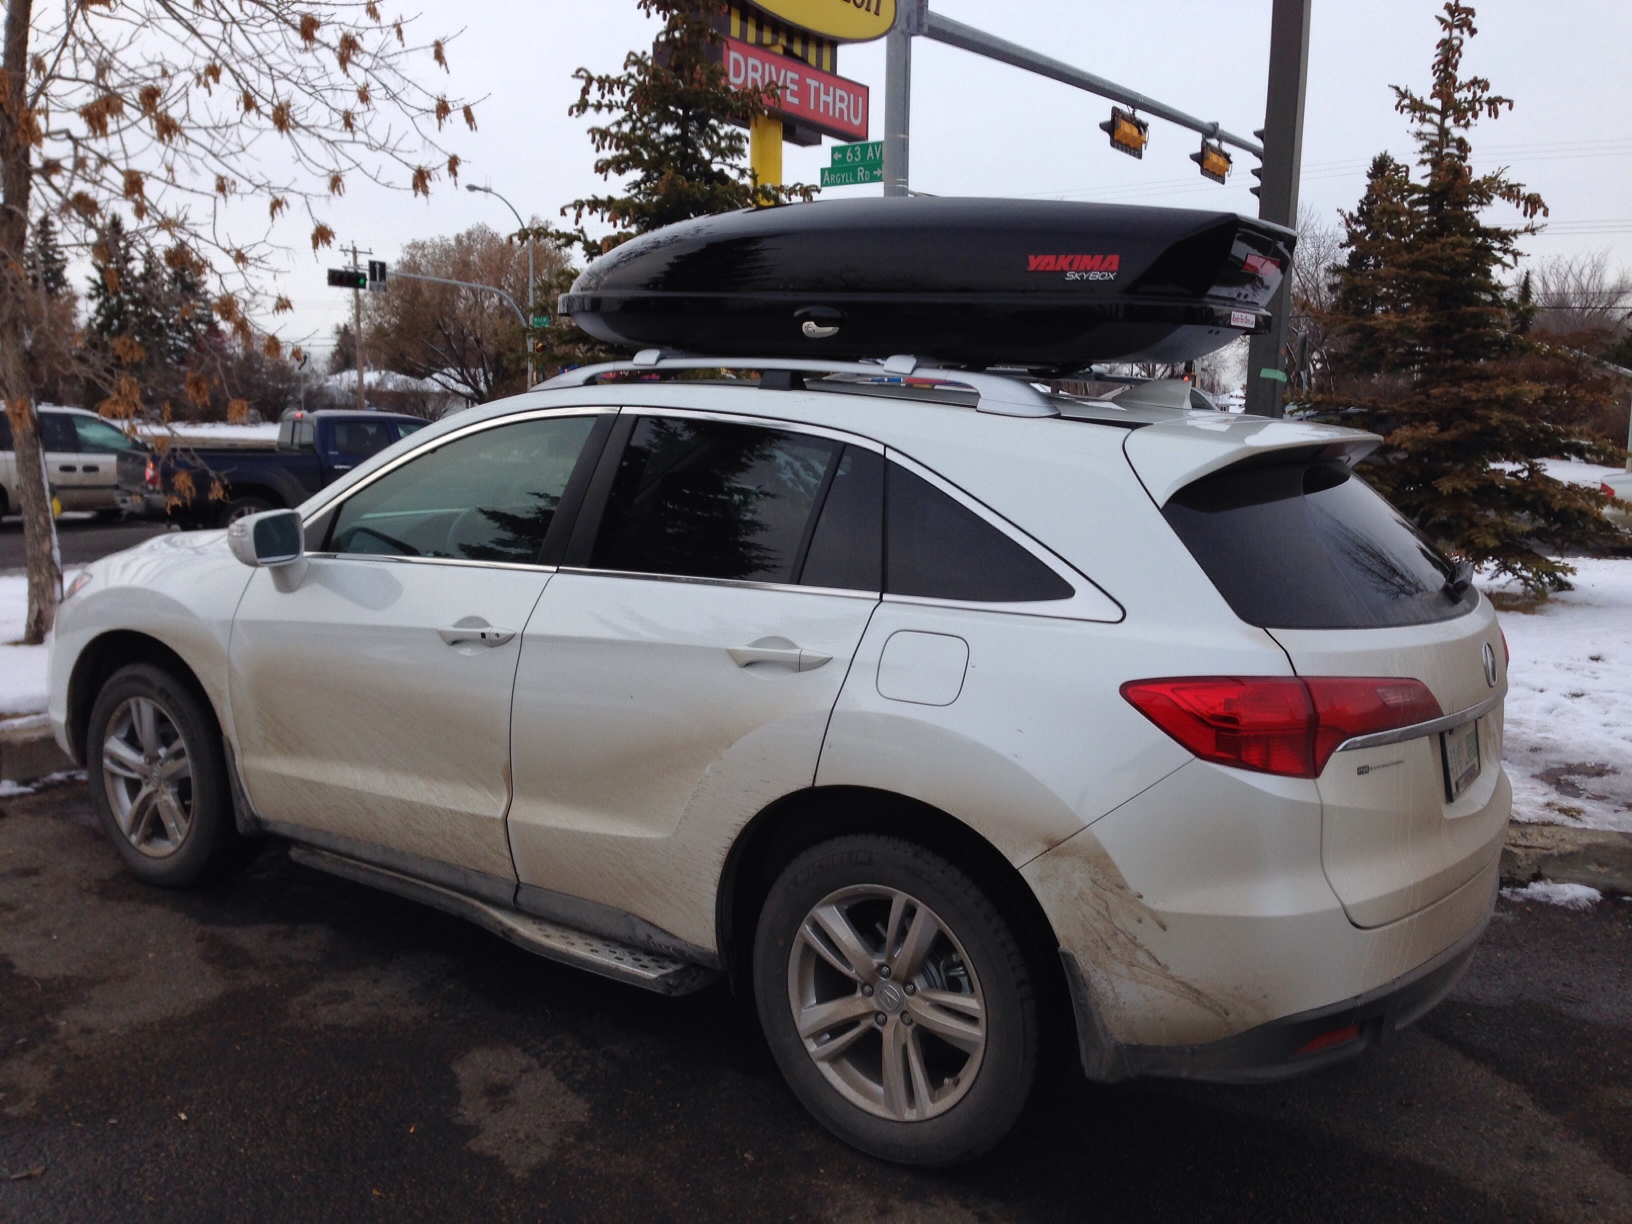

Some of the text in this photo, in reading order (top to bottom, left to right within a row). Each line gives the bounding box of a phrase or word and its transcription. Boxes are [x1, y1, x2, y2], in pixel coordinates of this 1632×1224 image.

[729, 50, 863, 127] DRIVE THRU
[846, 144, 882, 162] 63 AV
[1028, 254, 1120, 271] YAKIMA
